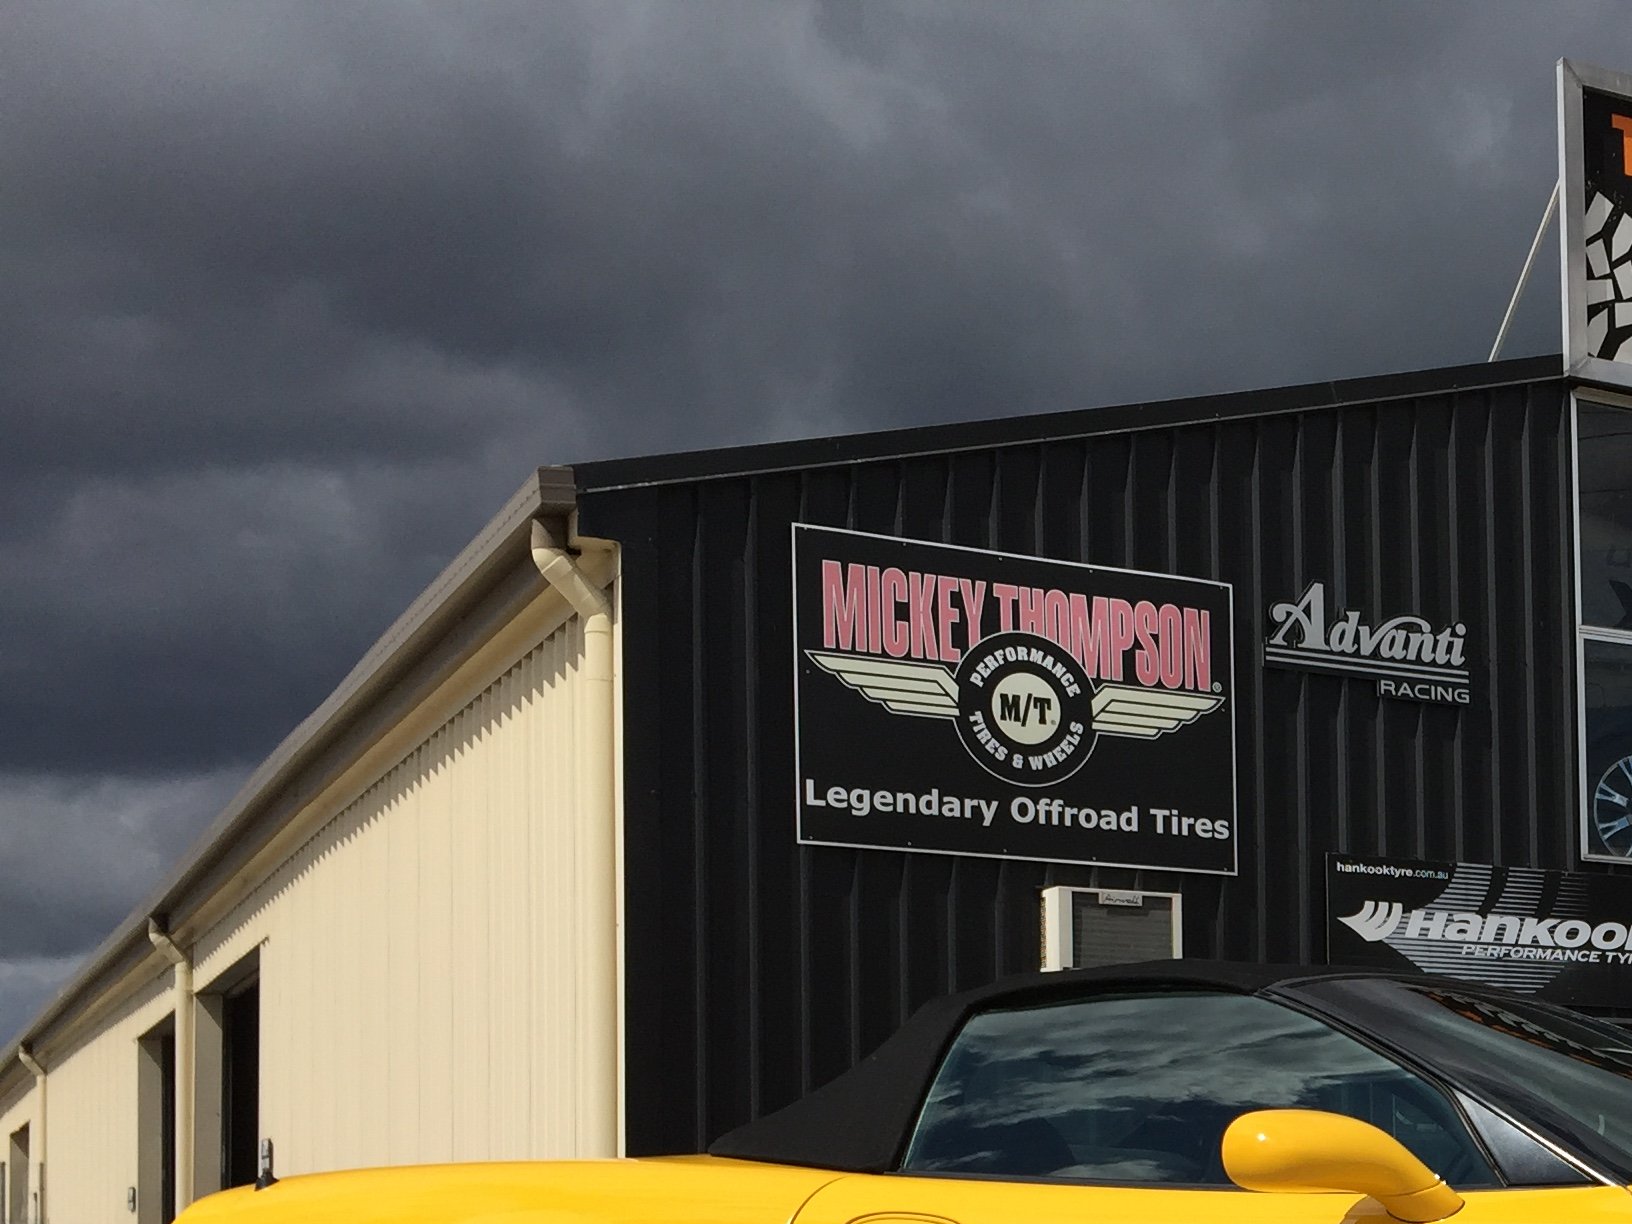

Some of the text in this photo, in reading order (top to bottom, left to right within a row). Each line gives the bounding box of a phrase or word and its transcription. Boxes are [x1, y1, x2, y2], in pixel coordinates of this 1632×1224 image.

[821, 560, 1212, 692] MICKEY THOMPSON
[1272, 582, 1467, 667] Advanti
[969, 645, 1081, 698] PERFORMANCE
[1381, 678, 1470, 704] RACING
[999, 692, 1052, 728] M/T
[968, 710, 1084, 771] TIRES & WHEELS
[805, 779, 1230, 841] Legendary Offroad Tires
[1336, 862, 1449, 880] hankooktyre.com.au
[1461, 945, 1600, 963] PERFORMANCE
